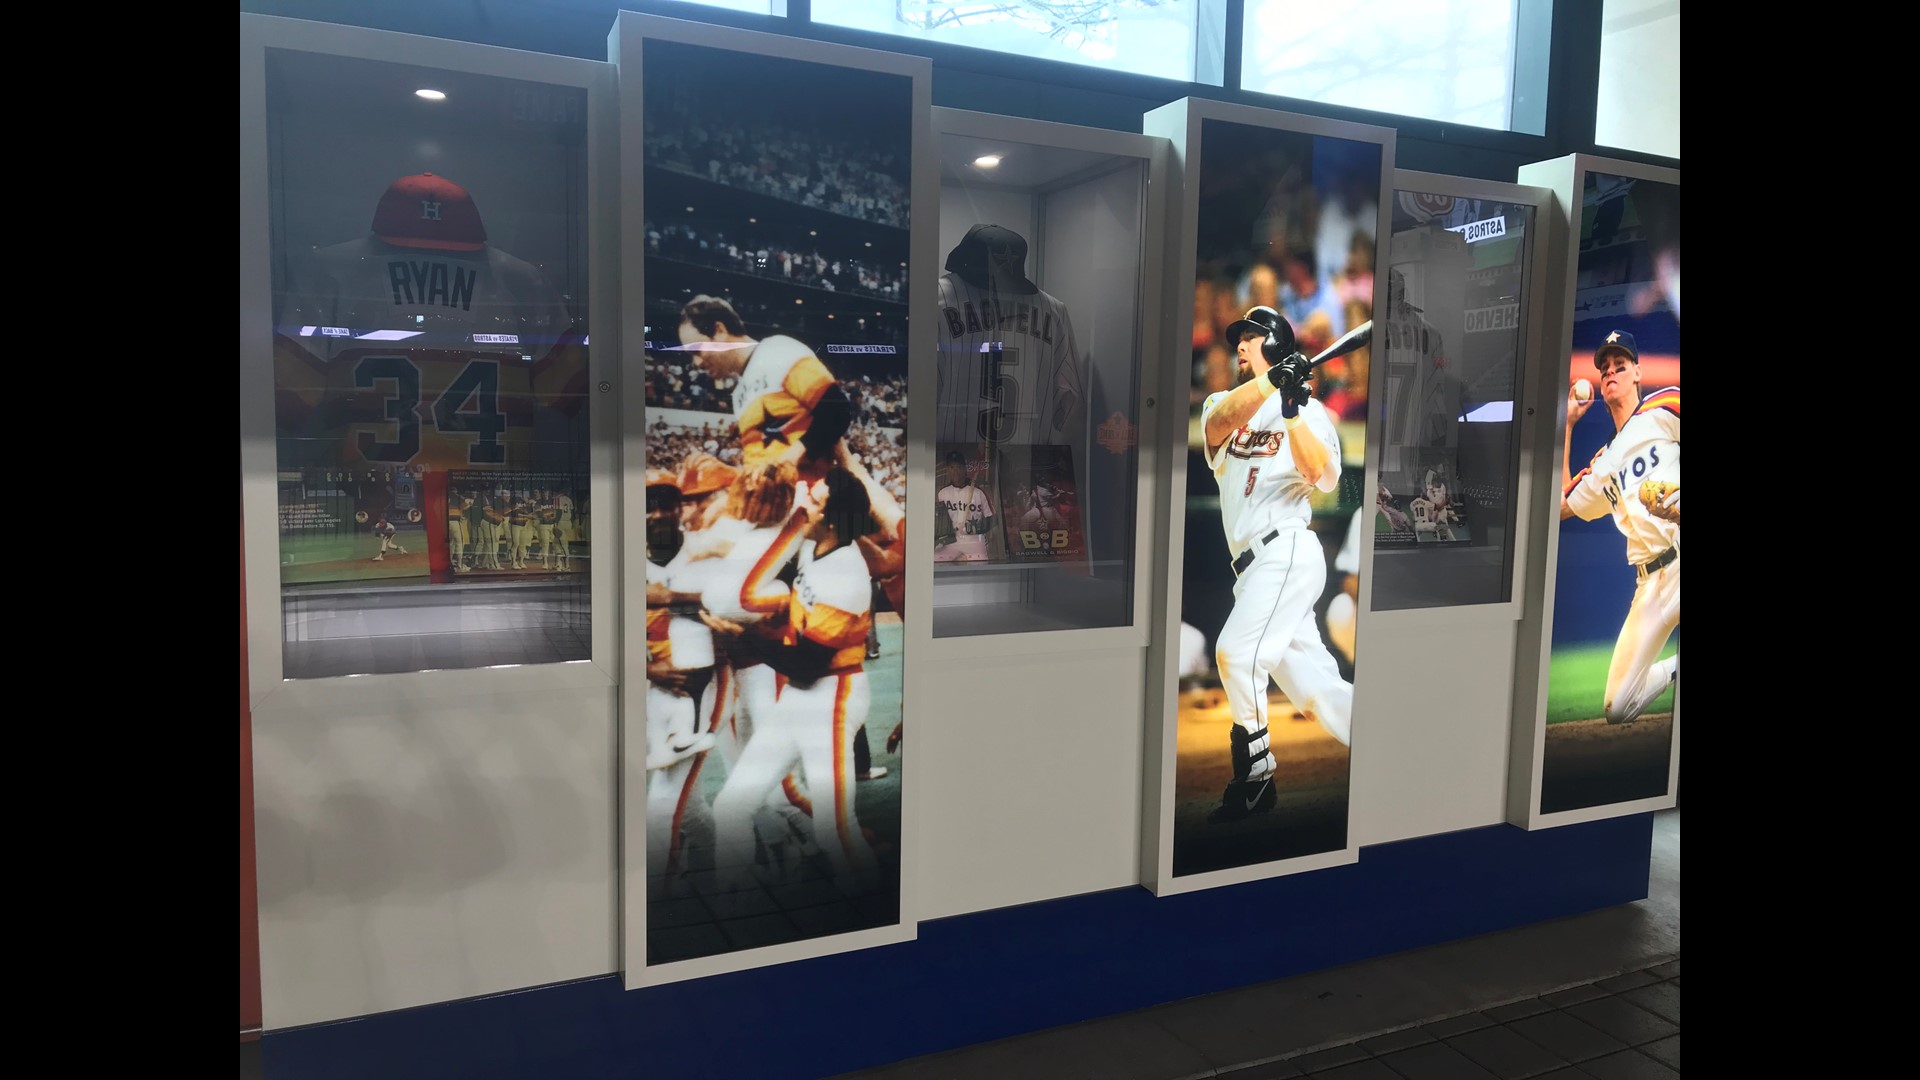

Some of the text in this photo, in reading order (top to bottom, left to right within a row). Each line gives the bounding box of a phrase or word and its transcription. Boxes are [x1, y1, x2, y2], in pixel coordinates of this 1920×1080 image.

[421, 200, 442, 221] H
[387, 261, 478, 312] RYAN
[942, 298, 1053, 345] BAGWELL
[353, 354, 508, 466] 34
[977, 346, 1020, 443] 5
[1387, 361, 1418, 445] 7
[946, 500, 982, 512] Astros
[1245, 467, 1260, 498] 5
[1414, 506, 1425, 517] 10
